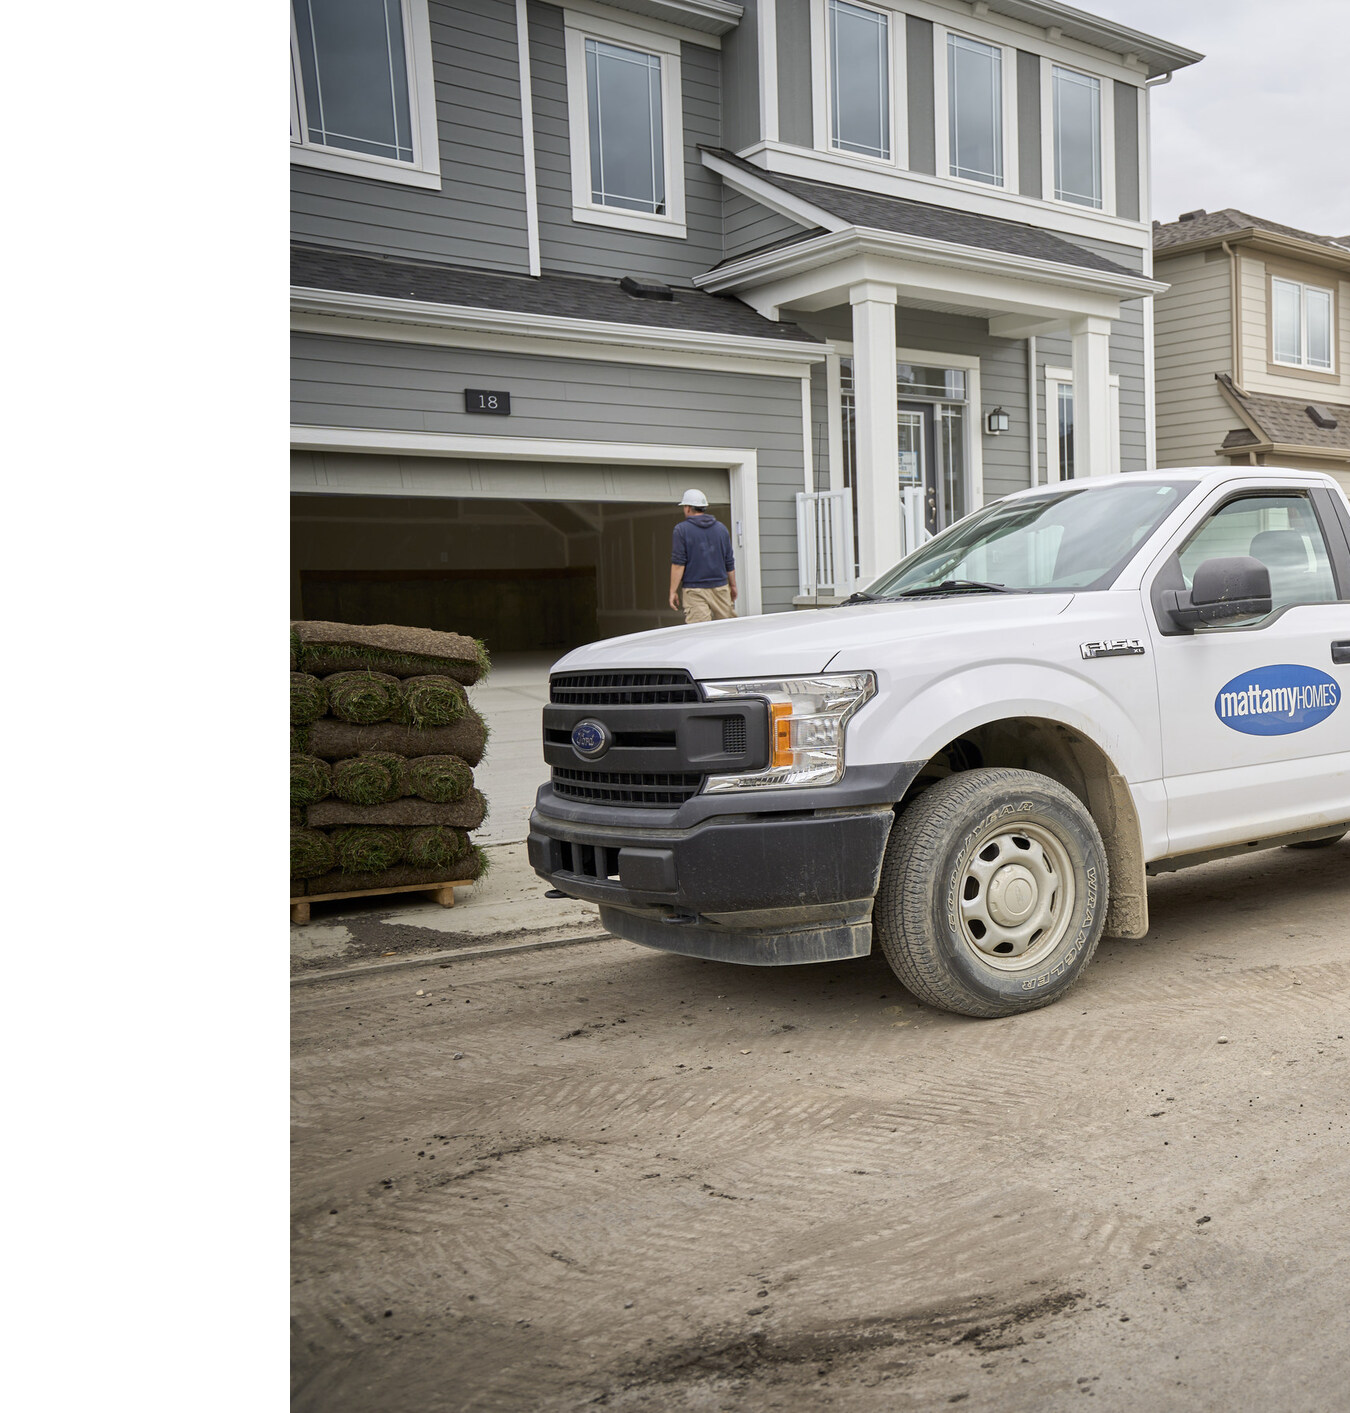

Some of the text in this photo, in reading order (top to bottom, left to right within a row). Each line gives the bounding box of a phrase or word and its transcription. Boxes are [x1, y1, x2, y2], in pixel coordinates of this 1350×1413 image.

[479, 394, 498, 409] 18
[946, 801, 1034, 934] GOODYEAR
[1021, 866, 1097, 991] WRANGLER
